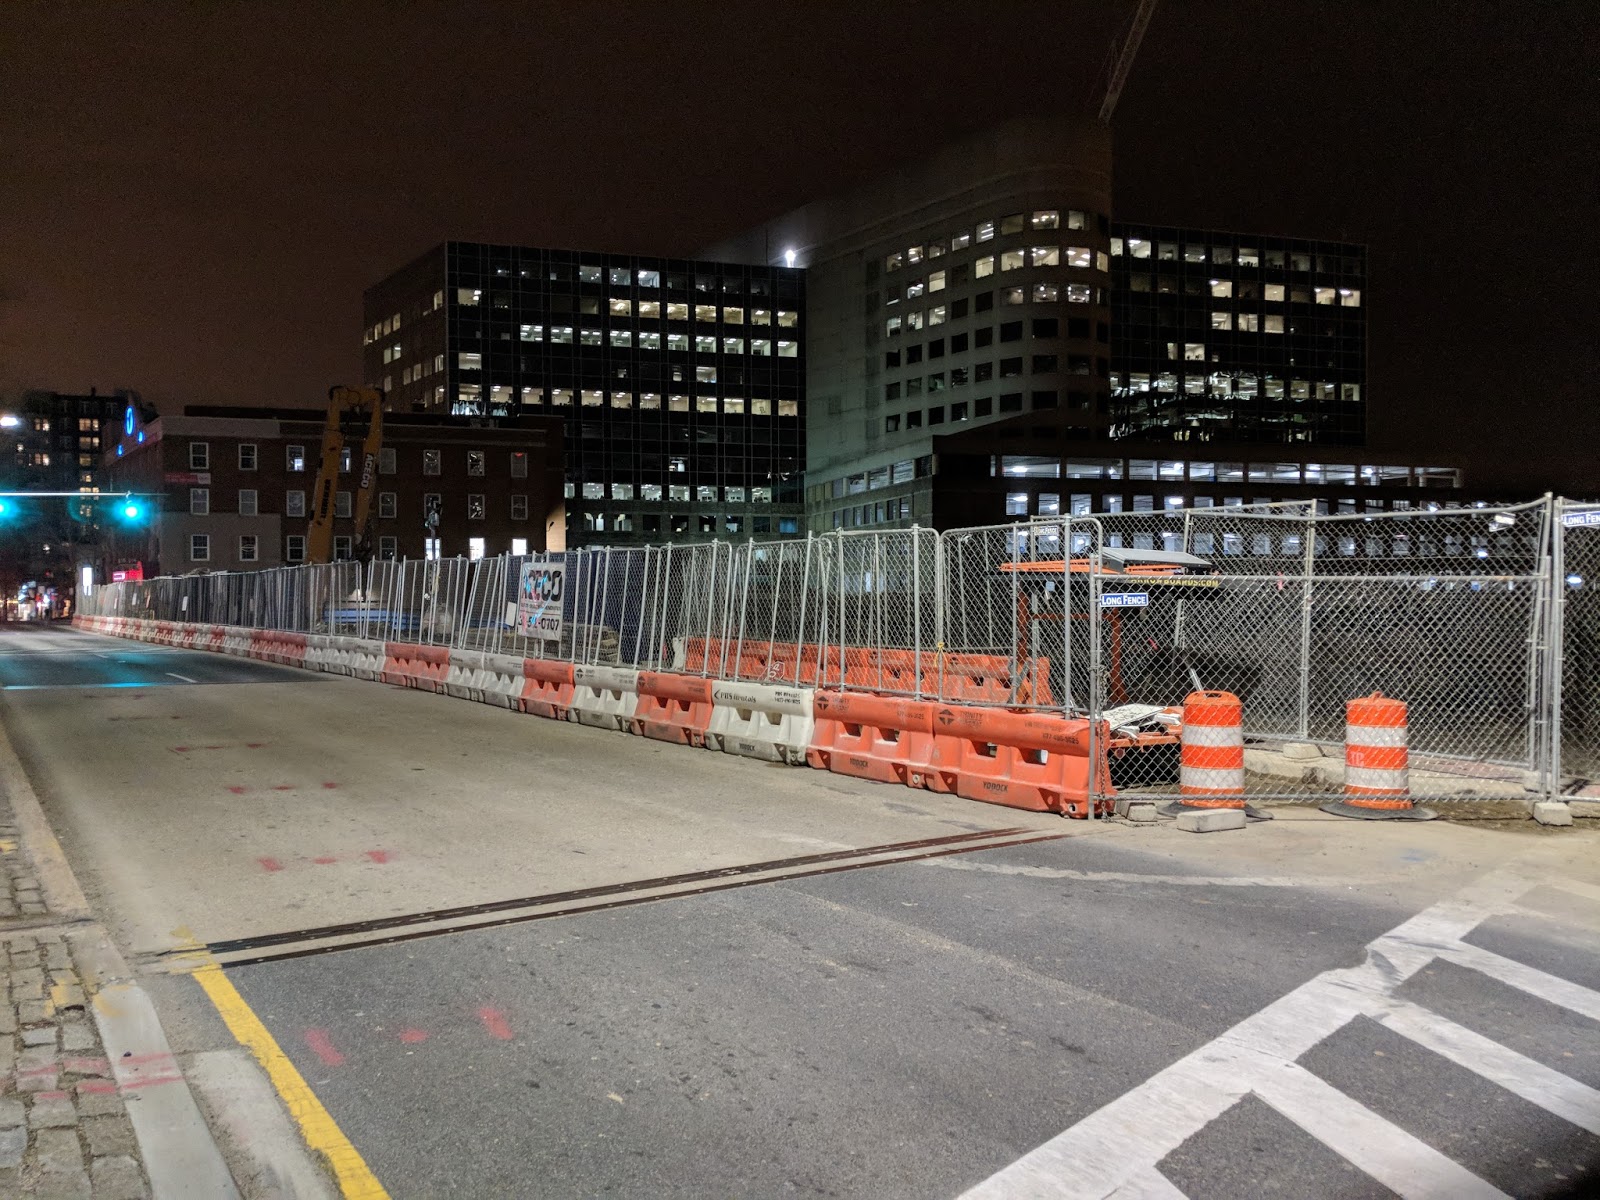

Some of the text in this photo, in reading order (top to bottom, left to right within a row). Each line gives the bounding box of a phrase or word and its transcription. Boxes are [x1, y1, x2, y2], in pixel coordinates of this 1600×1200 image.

[361, 453, 374, 489] ACECO
[1563, 515, 1585, 526] LONG
[1101, 595, 1146, 605] LONG FENCE
[982, 780, 1008, 792] YODOCK
